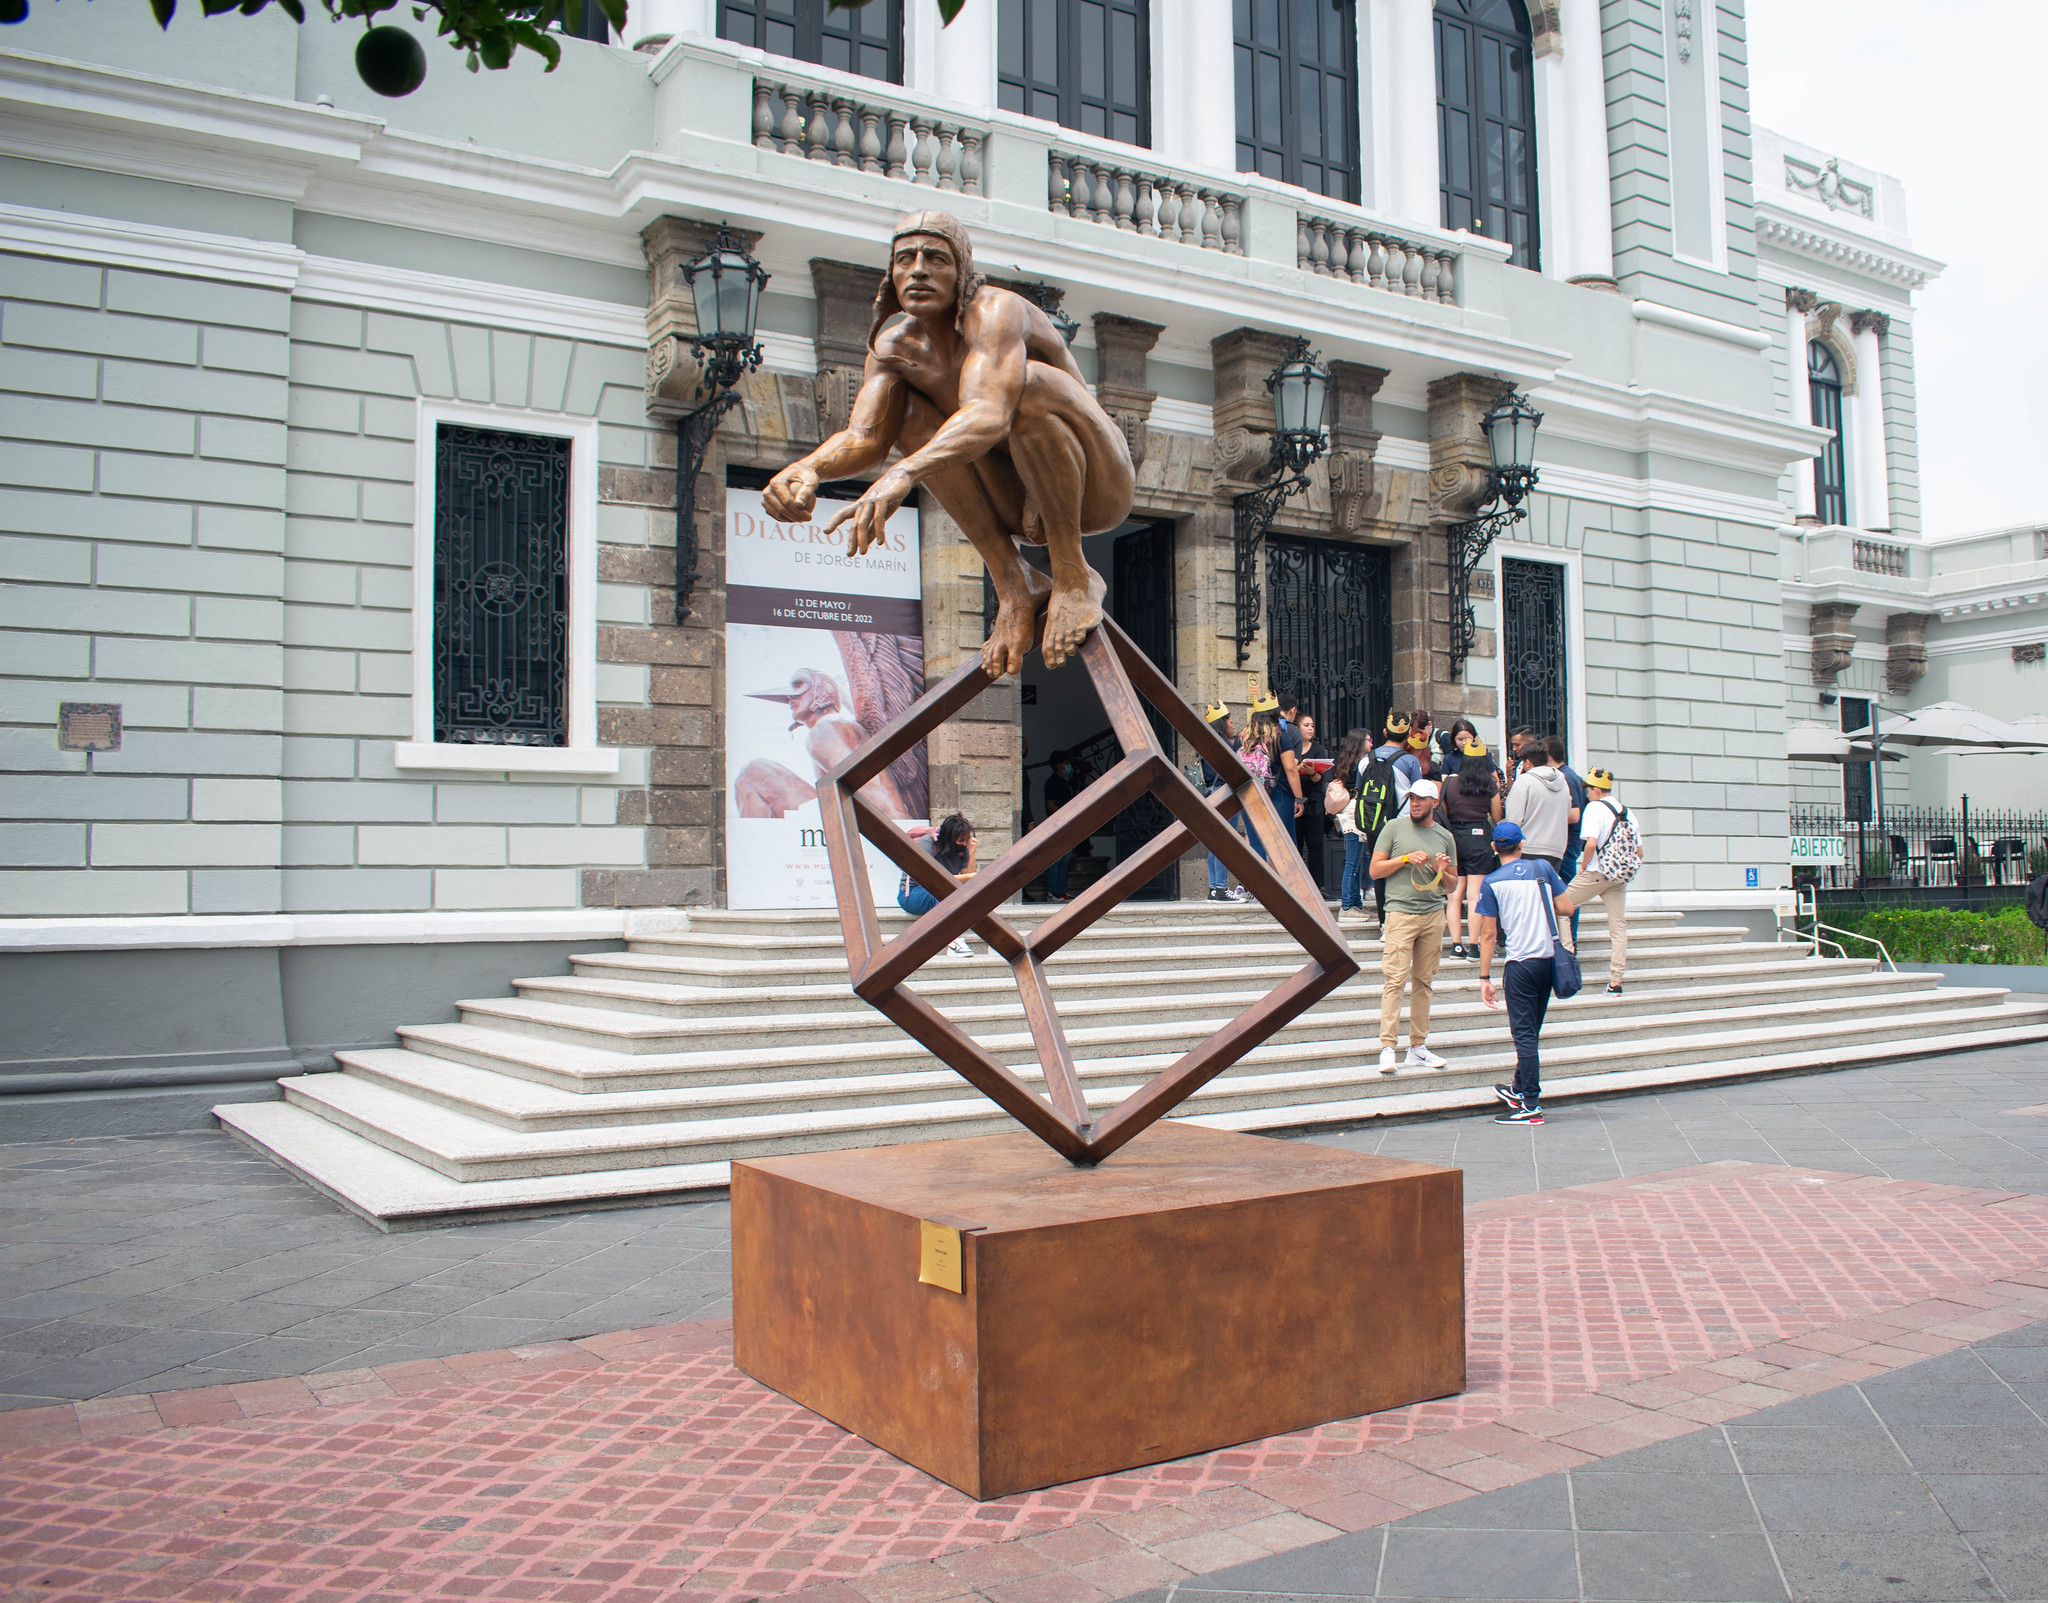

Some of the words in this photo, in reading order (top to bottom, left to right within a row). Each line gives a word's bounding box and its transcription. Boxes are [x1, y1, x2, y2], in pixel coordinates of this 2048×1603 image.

[795, 552, 811, 564] DE
[816, 553, 861, 568] JORGE
[866, 558, 906, 572] MARÍN
[795, 598, 804, 607] 12
[806, 599, 818, 608] DE
[820, 600, 846, 610] MAYO
[773, 608, 782, 617] 16
[784, 609, 796, 618] DE
[798, 610, 839, 621] OCTUBRE
[841, 613, 853, 622] DE
[855, 614, 873, 624] 2022
[1791, 837, 1844, 857] ABIERTO
